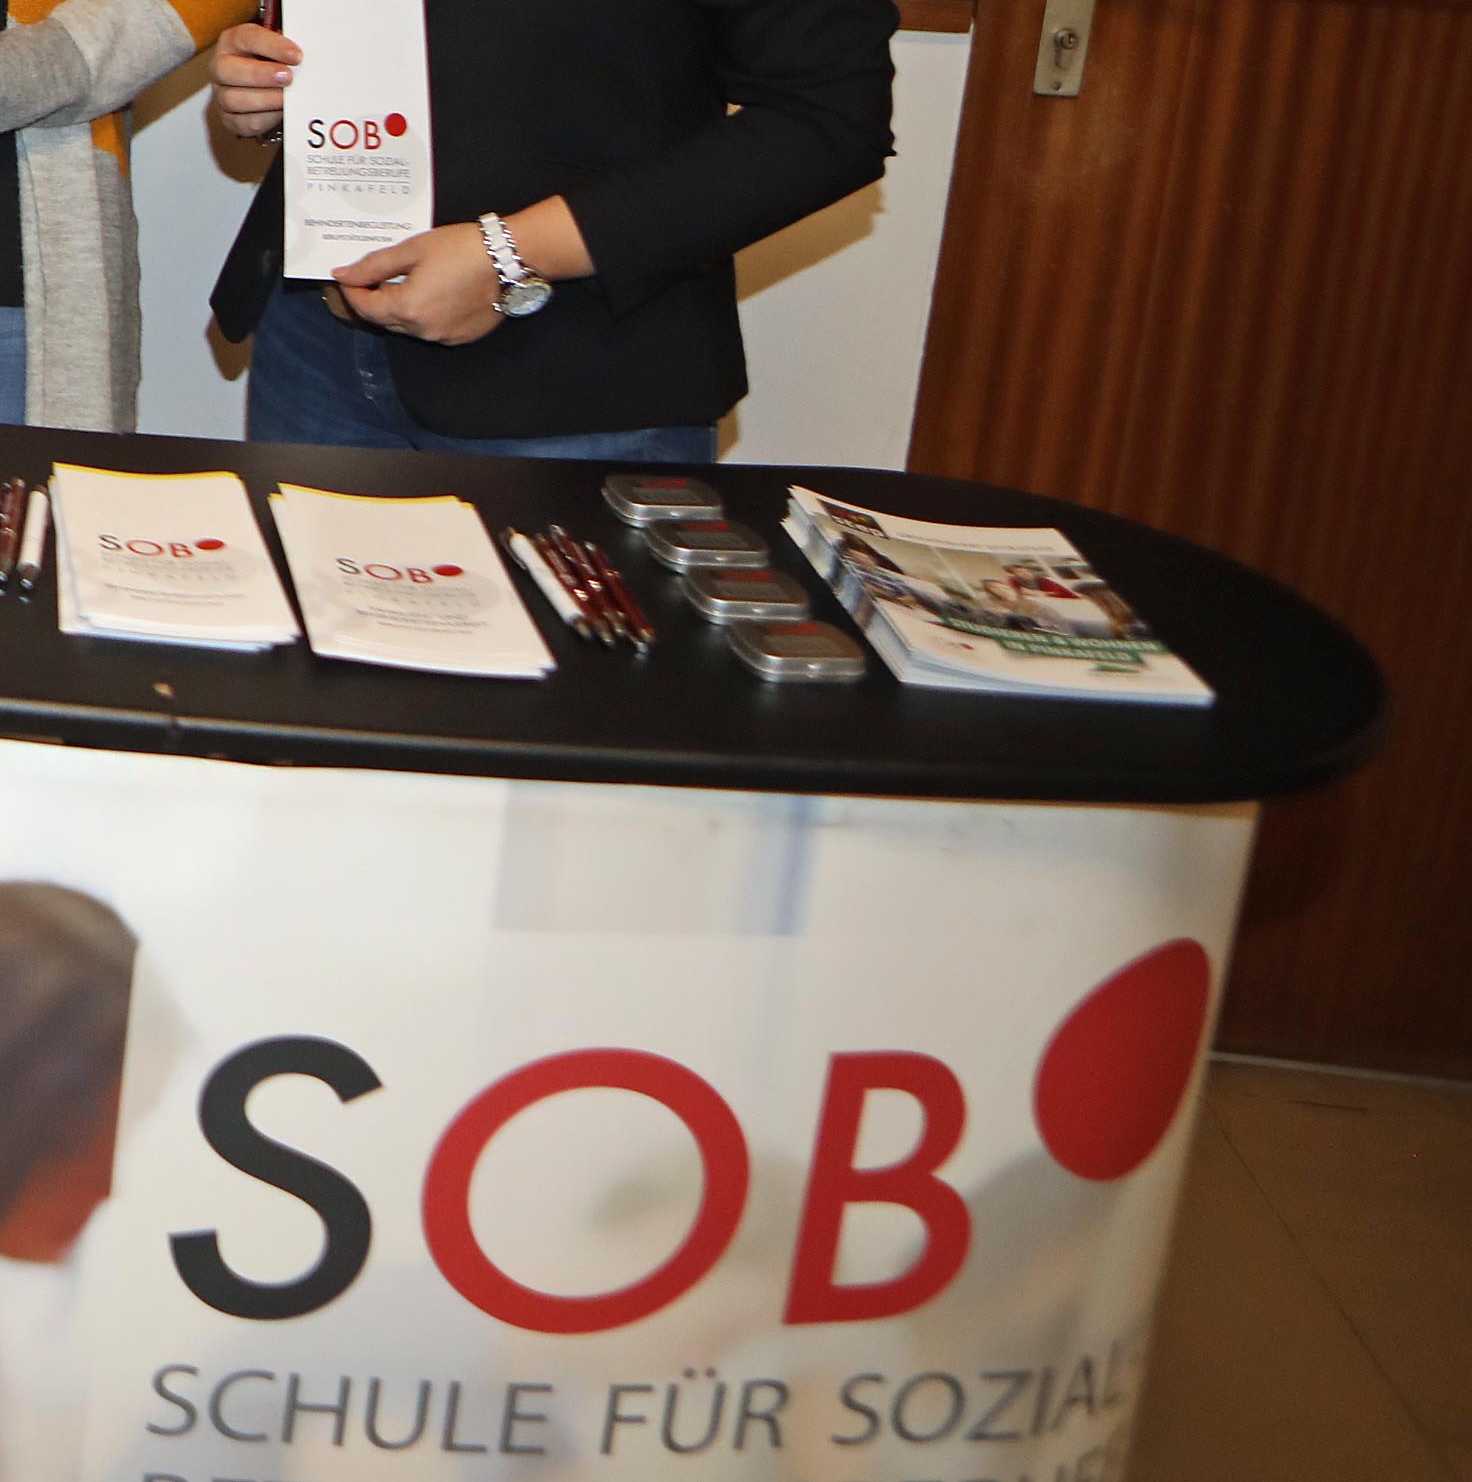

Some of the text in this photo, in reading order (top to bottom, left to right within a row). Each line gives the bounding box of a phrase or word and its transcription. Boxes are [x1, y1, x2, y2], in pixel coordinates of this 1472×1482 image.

[307, 119, 382, 150] SOB
[307, 182, 410, 194] PINKAFELD
[98, 534, 194, 558] SOB
[336, 558, 433, 584] SOB
[169, 1033, 973, 1336] SOB
[146, 1362, 556, 1456] SCHULE
[598, 1366, 790, 1456] FÜR
